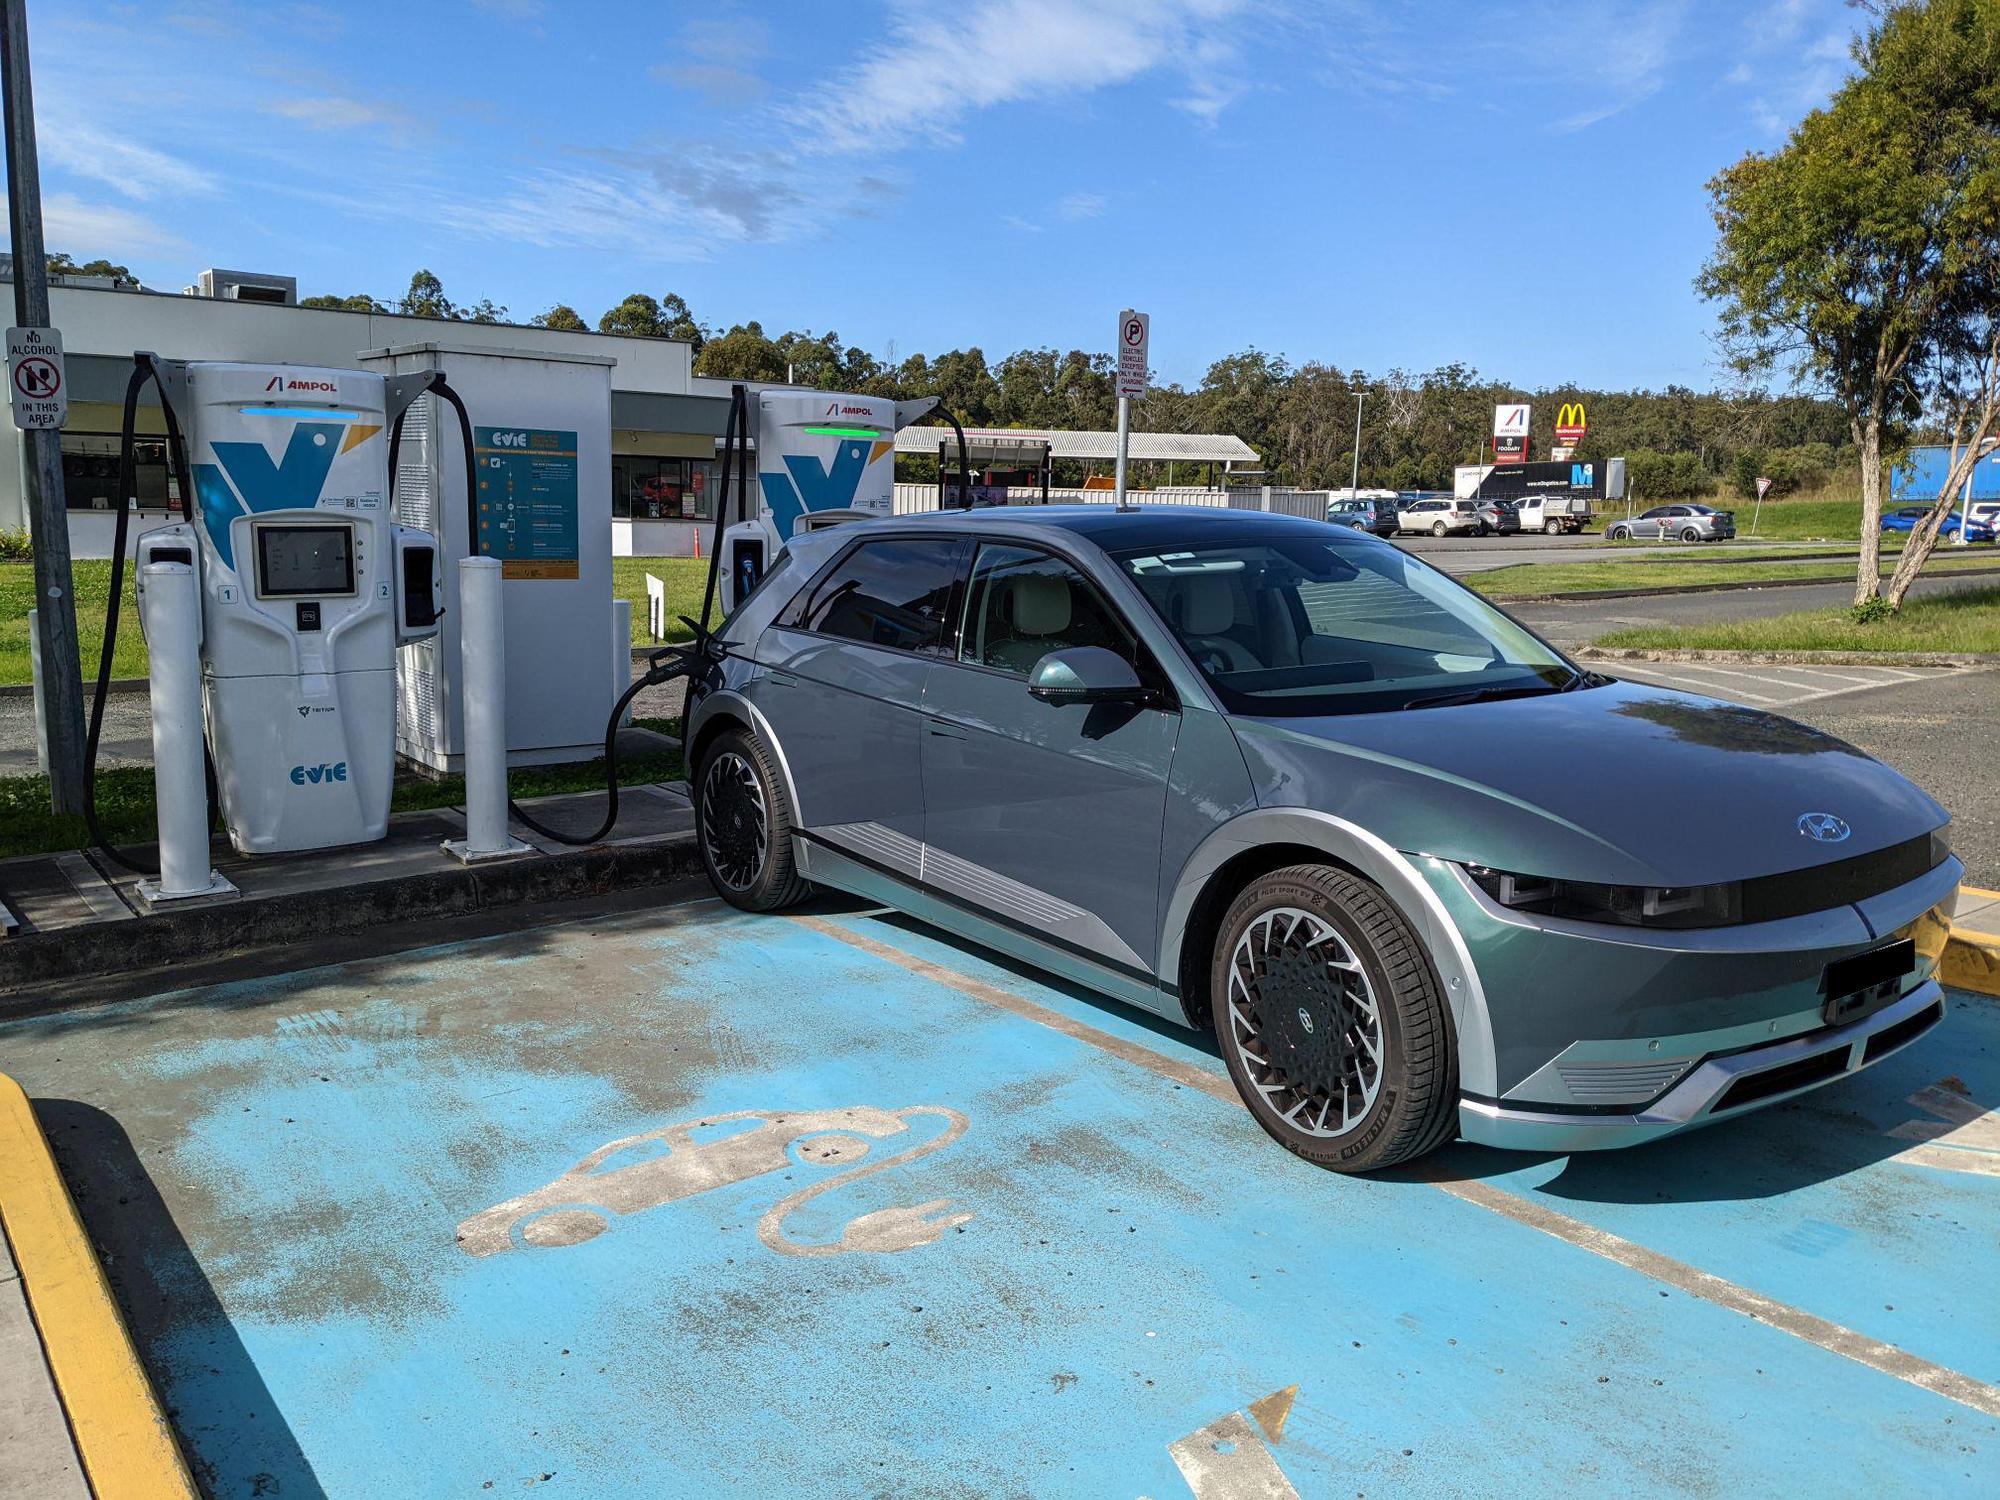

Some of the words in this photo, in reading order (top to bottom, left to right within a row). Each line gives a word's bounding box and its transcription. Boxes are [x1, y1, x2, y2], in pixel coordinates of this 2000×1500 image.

[27, 334, 41, 343] NO
[12, 346, 58, 355] ALCOHOL
[288, 381, 337, 392] AMPOL
[22, 403, 32, 411] IN
[36, 403, 59, 412] THIS
[841, 407, 872, 415] AMPOL
[28, 414, 55, 423] AREA
[224, 590, 230, 599] 1
[382, 586, 388, 596] 2
[1261, 887, 1276, 896] PILOT
[1343, 1107, 1389, 1160] MICHELIN
